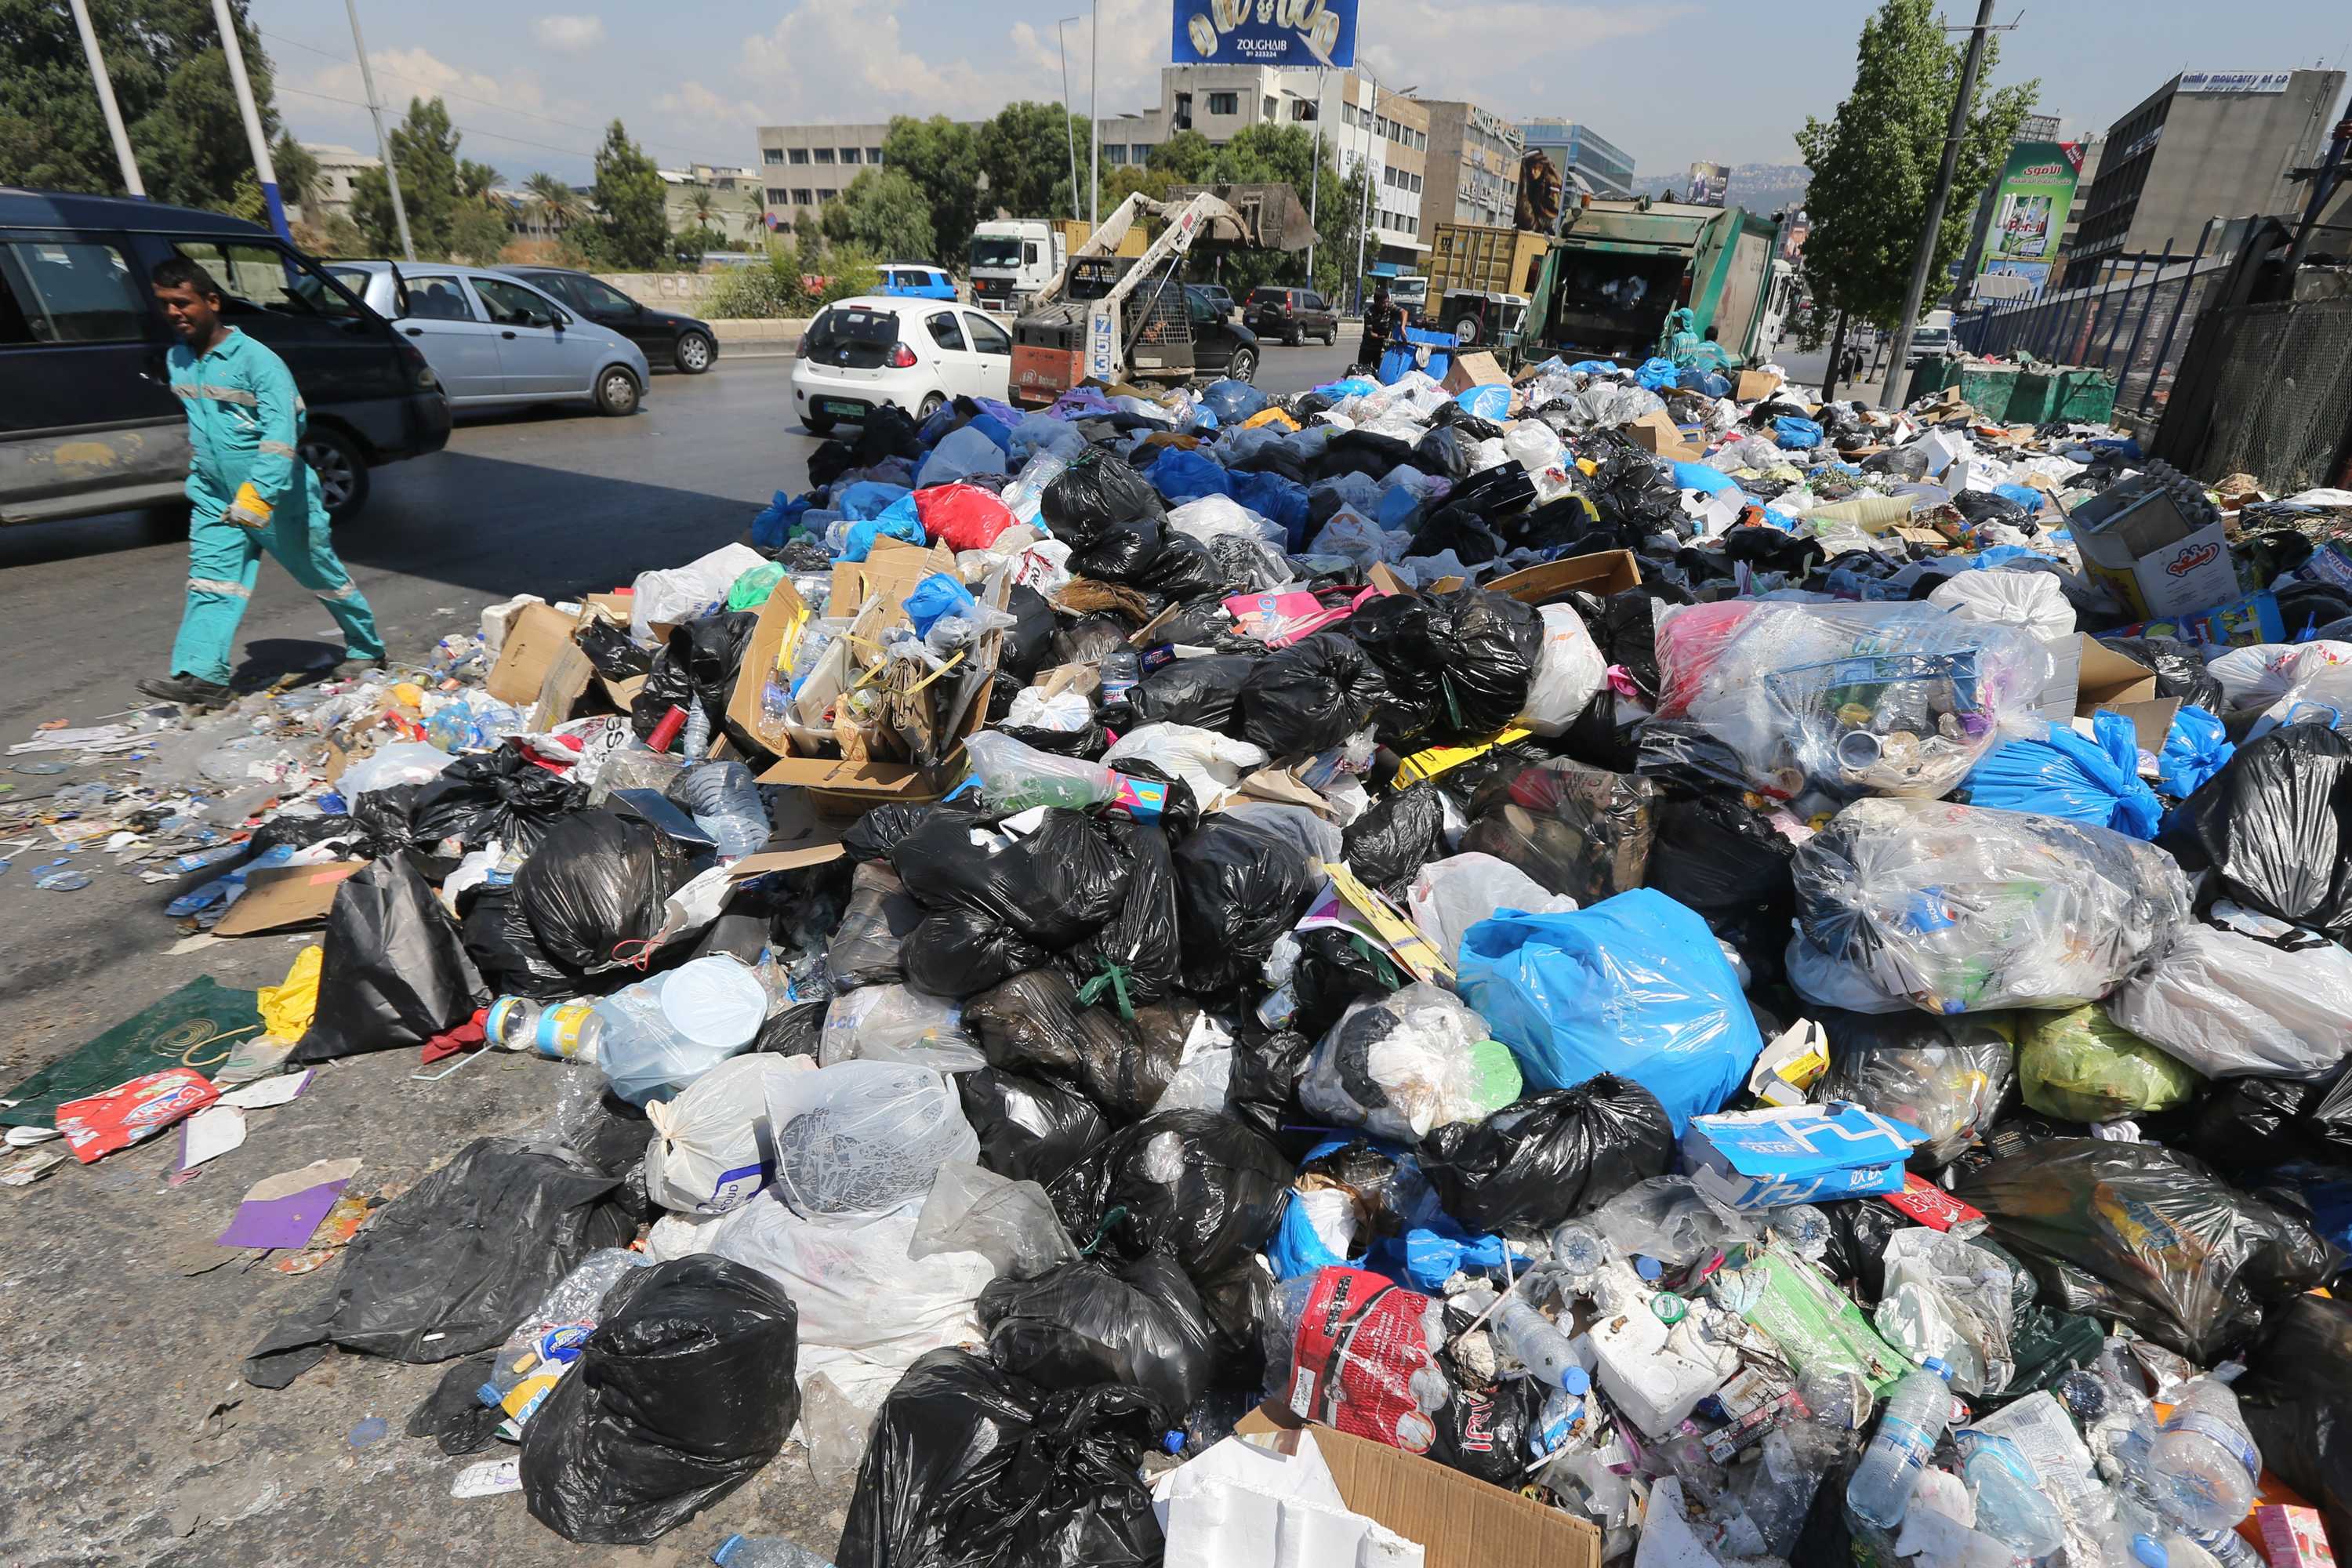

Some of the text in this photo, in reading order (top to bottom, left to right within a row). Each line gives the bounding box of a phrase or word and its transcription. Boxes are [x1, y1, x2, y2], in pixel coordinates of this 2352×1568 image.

[1237, 39, 1287, 51] ZOUGHAIB
[2183, 72, 2209, 83] emile
[2211, 74, 2259, 85] moucarry
[2261, 74, 2273, 83] et
